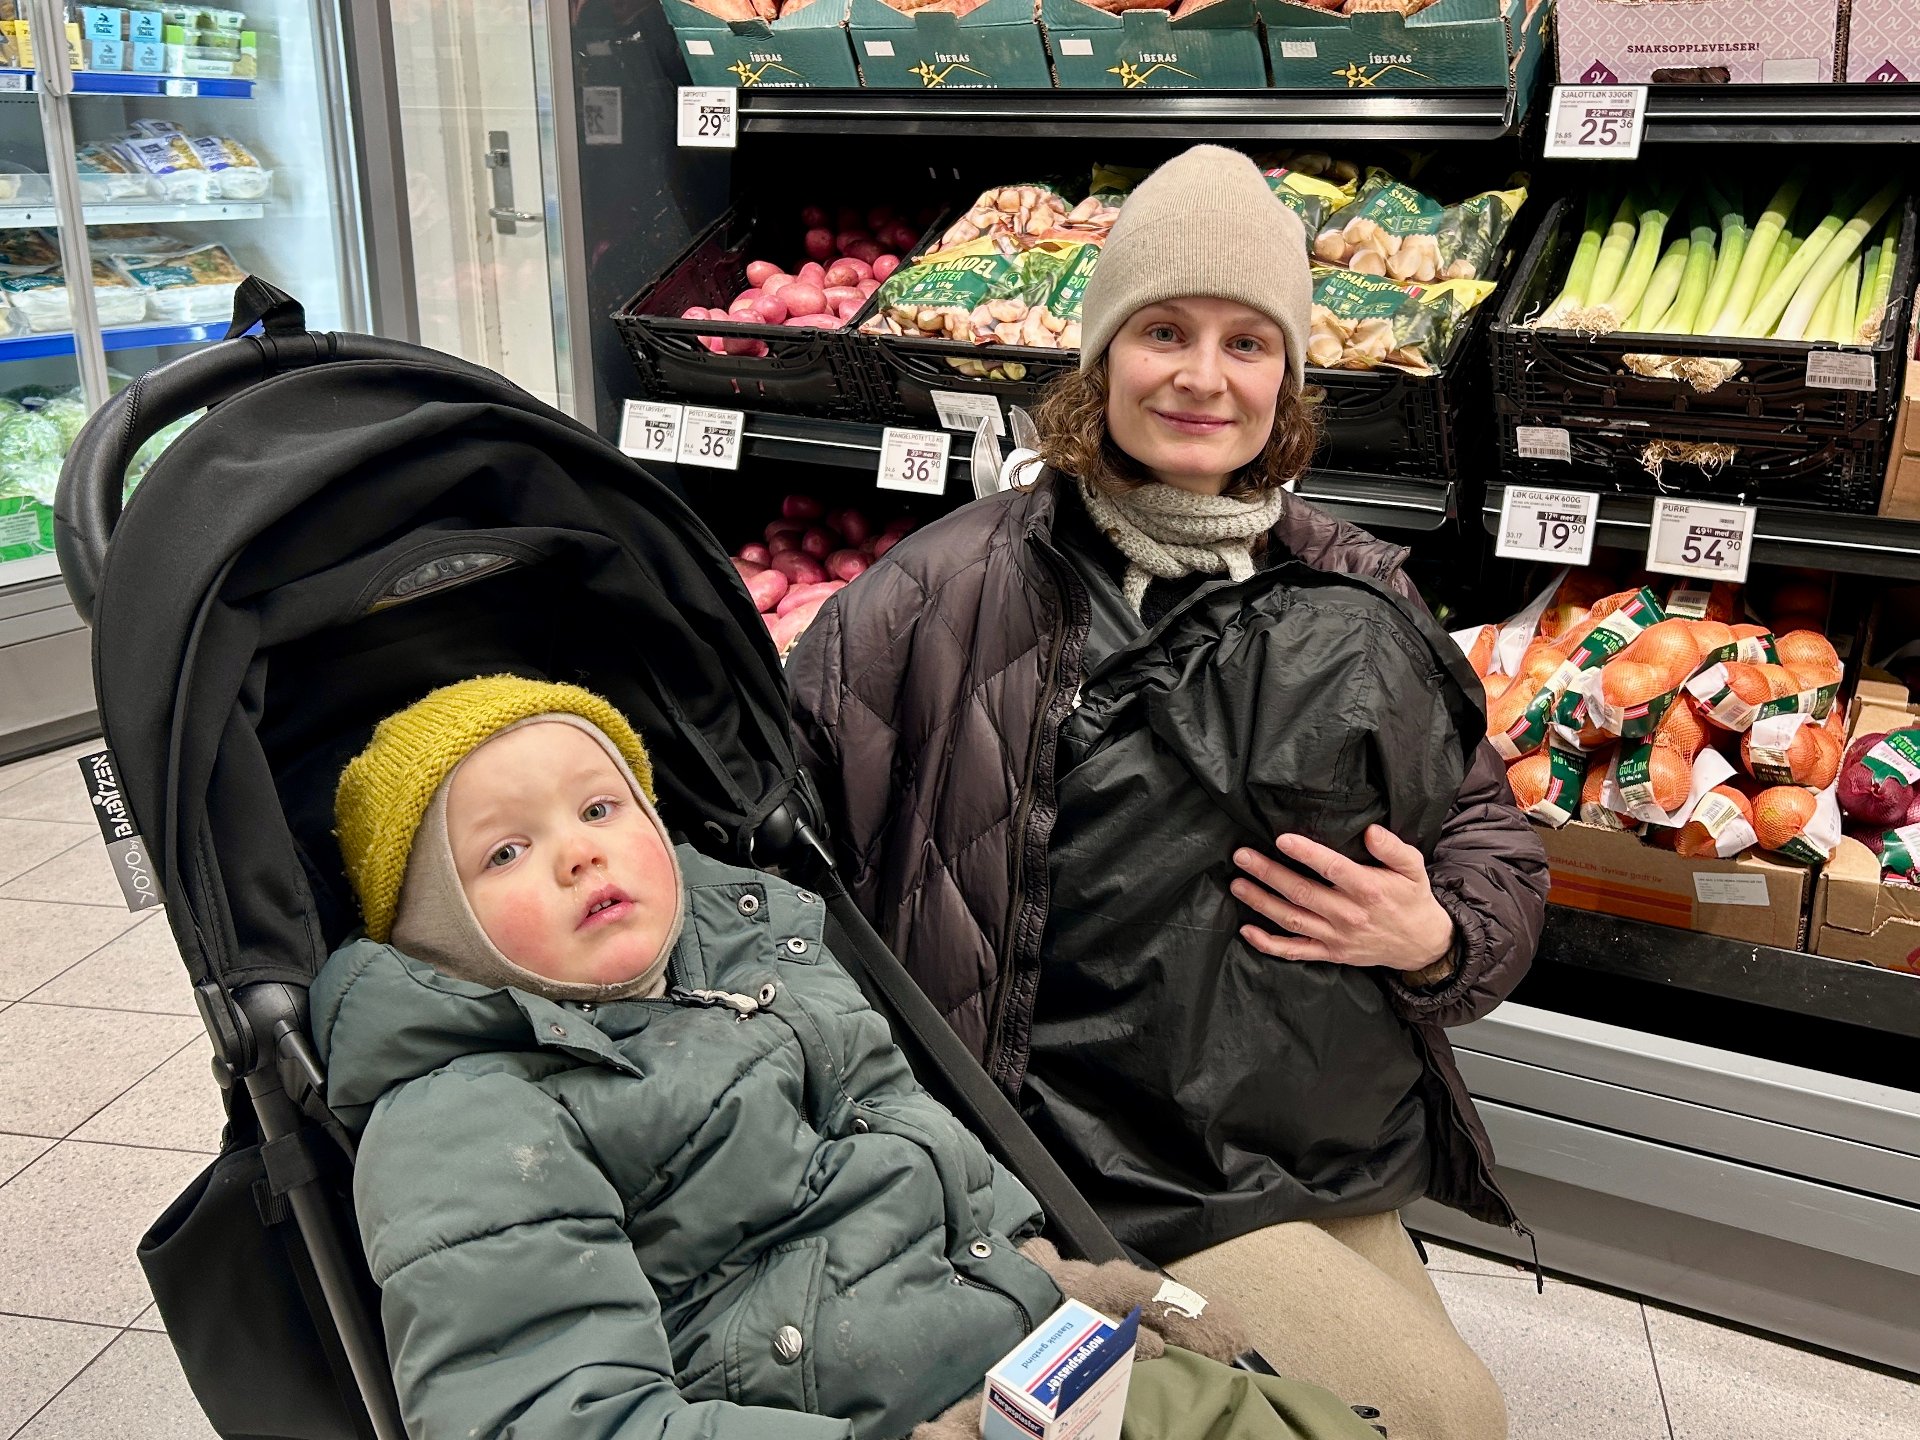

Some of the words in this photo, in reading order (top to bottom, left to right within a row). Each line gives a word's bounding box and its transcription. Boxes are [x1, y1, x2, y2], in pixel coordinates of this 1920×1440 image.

[1627, 43, 1760, 53] SMAKSOPPLEVELSER!
[698, 114, 722, 137] 29
[1578, 118, 1618, 146] 25
[1619, 119, 1633, 129] 36
[645, 428, 665, 450] 19
[699, 434, 724, 457] 36
[902, 457, 930, 482] 36
[930, 460, 941, 469] 90
[1512, 491, 1527, 499] LØK
[1528, 492, 1543, 500] GUL
[1561, 495, 1581, 503] 600G
[1662, 504, 1690, 513] PURRE
[1538, 521, 1570, 549] 19
[1571, 524, 1585, 534] 90
[1681, 535, 1724, 567] 54
[1726, 540, 1741, 551] 90
[1893, 735, 1920, 764] RØDLØ
[91, 754, 134, 838] BABYZEN
[125, 851, 155, 905] YOYO
[1049, 1321, 1075, 1345] Elastisk
[1021, 1342, 1049, 1369] gasbind
[1046, 1335, 1105, 1392] Norgesplaster
[993, 1391, 1041, 1432] Norgesplaster
